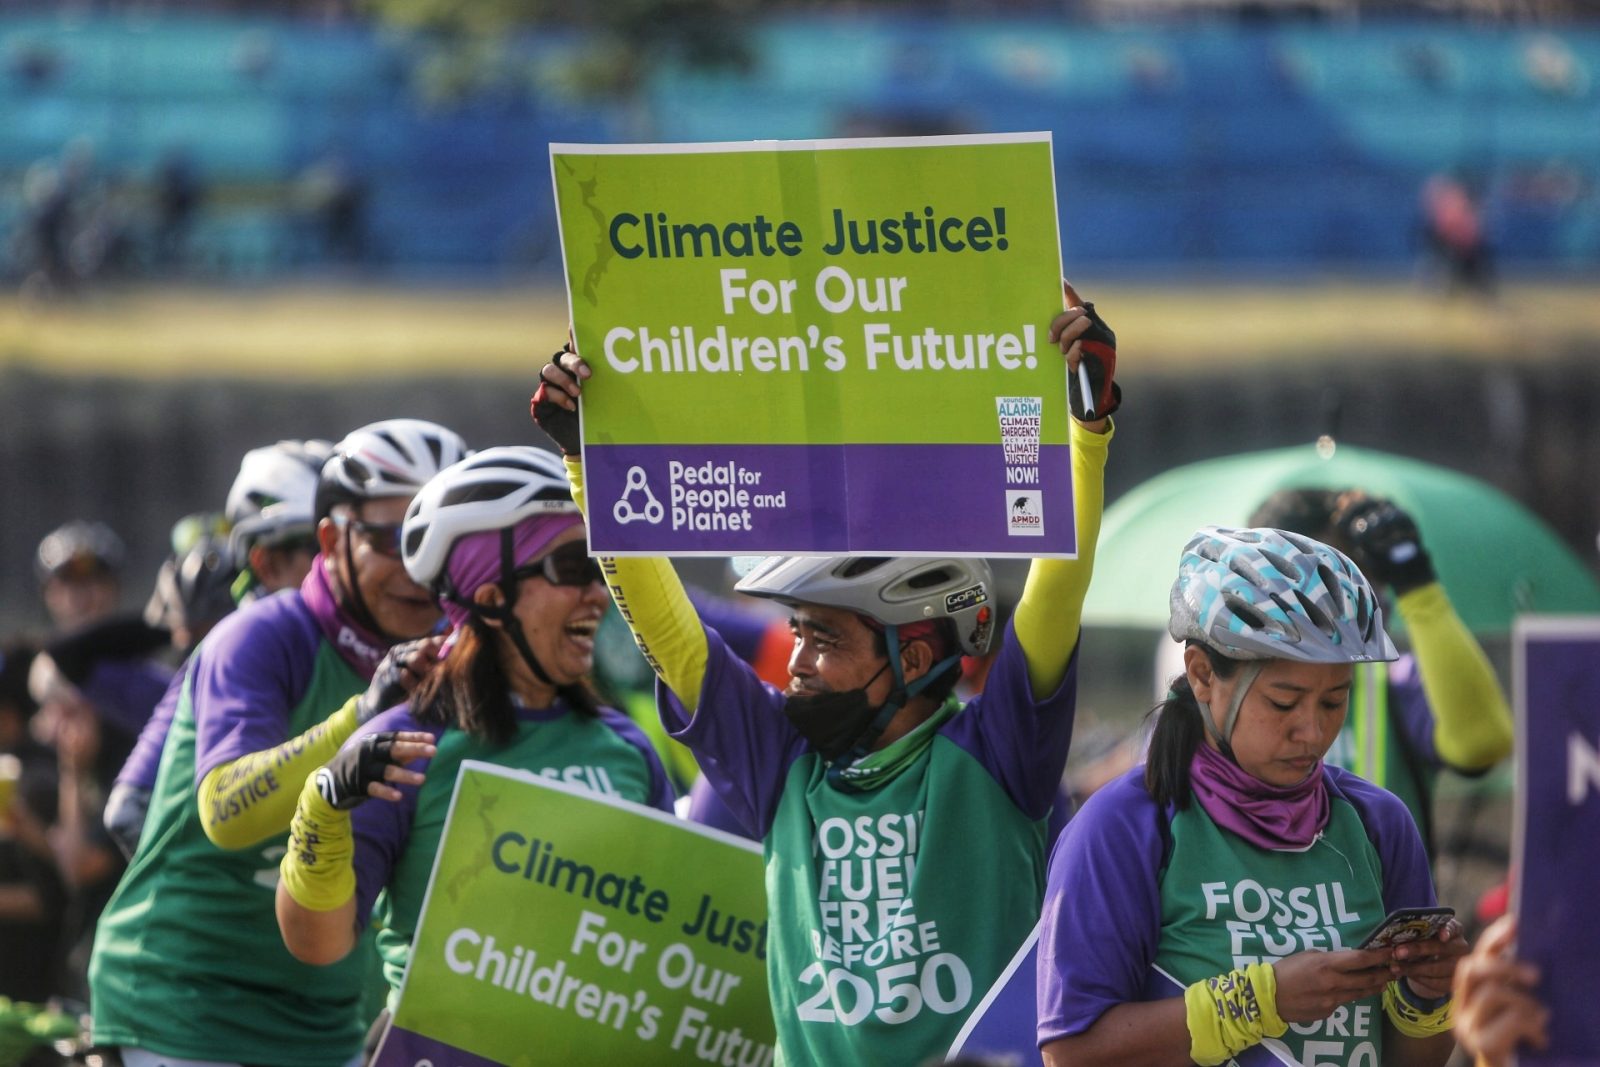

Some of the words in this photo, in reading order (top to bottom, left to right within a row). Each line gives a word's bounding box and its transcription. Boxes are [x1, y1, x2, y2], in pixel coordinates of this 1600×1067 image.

[609, 212, 803, 259] Climate
[822, 206, 1010, 256] Justice!
[720, 268, 797, 314] For
[815, 266, 908, 312] Our
[603, 325, 847, 374] Children's
[864, 323, 1039, 371] Future!
[999, 403, 1041, 416] ALARM!
[1000, 418, 1040, 426] CLIMATE
[1001, 427, 1040, 437] EMERGENCY!
[1004, 443, 1038, 453] CLIMATE
[669, 461, 735, 484] Pedal
[738, 468, 761, 484] for
[1006, 454, 1038, 464] JUSTICE
[1006, 467, 1039, 484] NOW!
[671, 484, 749, 512] People
[753, 491, 786, 508] and
[672, 507, 752, 531] Planet
[947, 588, 984, 605] GoPro
[211, 768, 279, 827] JUSTICE
[812, 810, 925, 859] OSSI
[491, 831, 670, 923] Climate
[682, 894, 768, 960] Just
[1201, 879, 1361, 928] FOSSIL
[1226, 920, 1353, 956] FUEL
[570, 910, 647, 973] For
[657, 943, 742, 1006] Our
[444, 927, 663, 1041] Children's
[671, 1006, 775, 1067] Futur
[796, 952, 973, 1026] 2050
